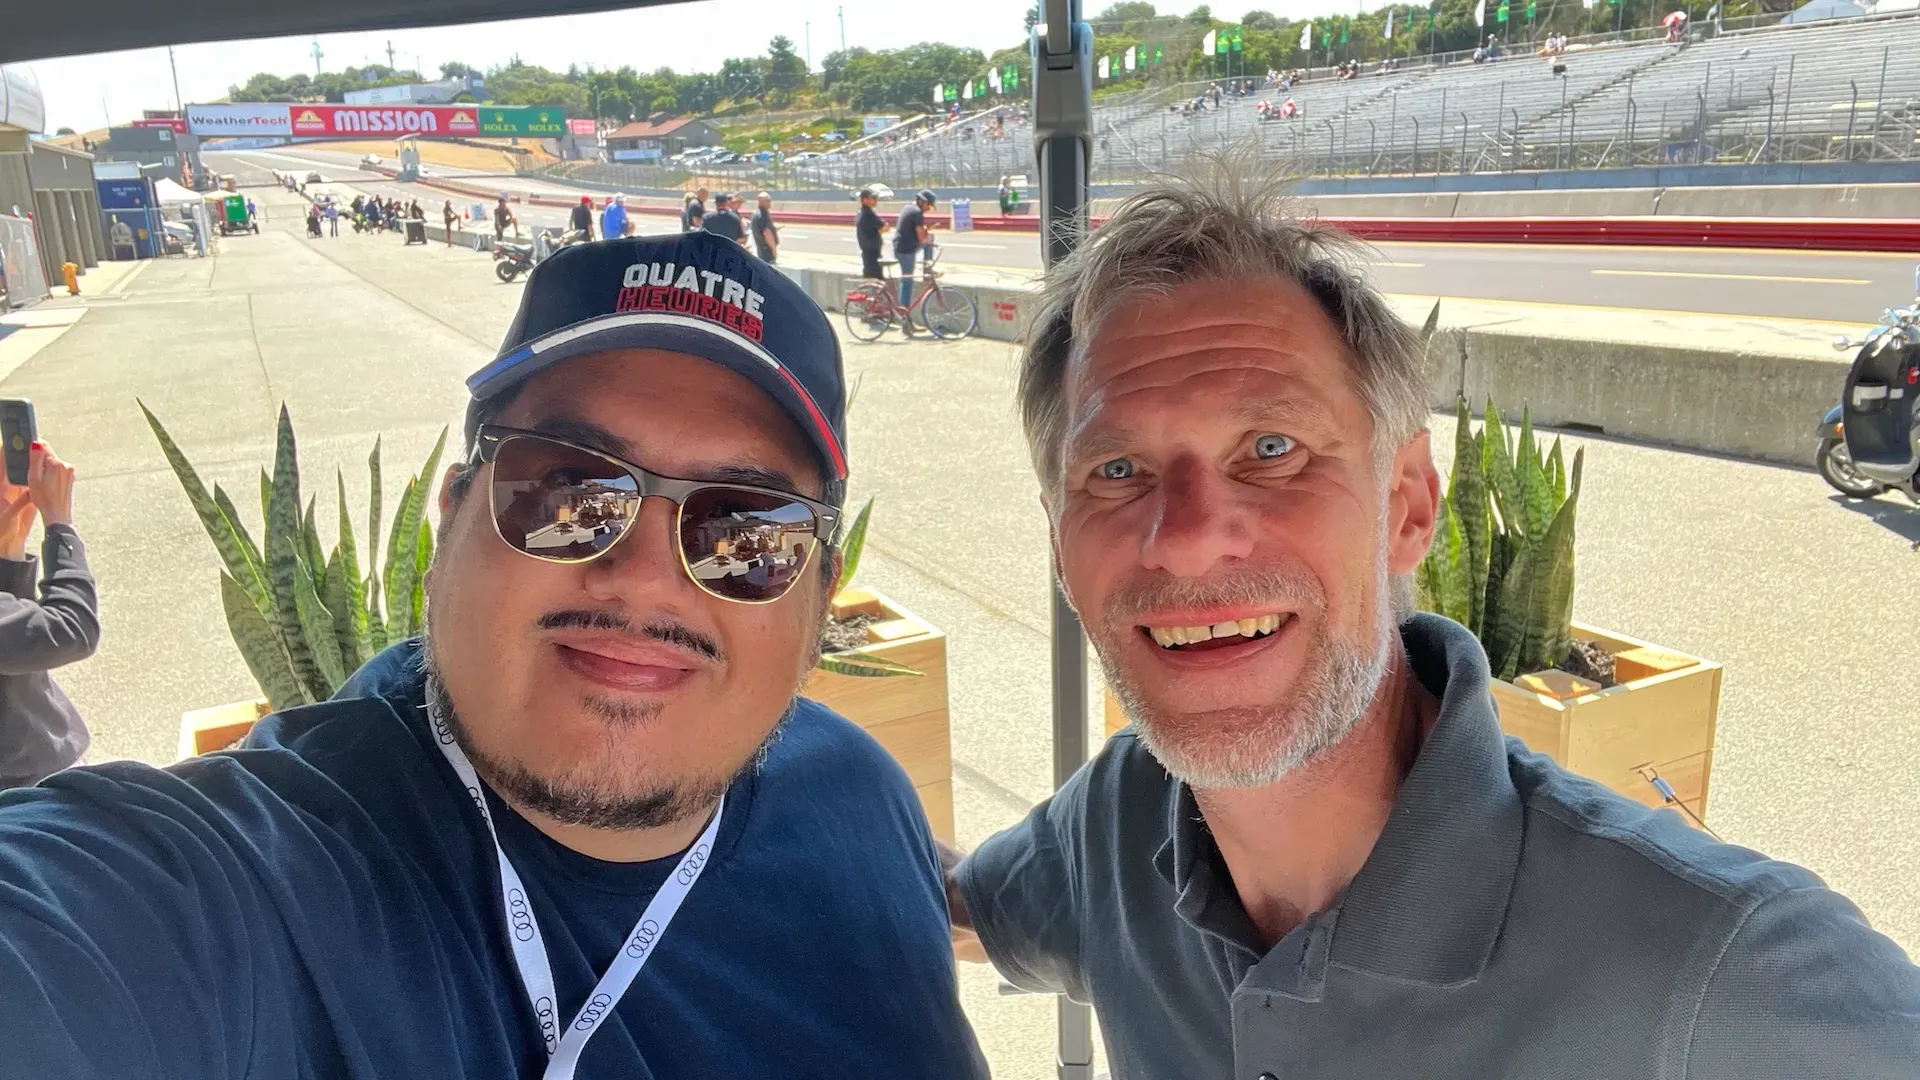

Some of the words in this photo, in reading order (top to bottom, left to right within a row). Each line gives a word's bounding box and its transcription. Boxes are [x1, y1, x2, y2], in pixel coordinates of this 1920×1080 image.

[192, 116, 287, 125] WeatherTech
[333, 110, 438, 131] MISSION
[484, 123, 518, 132] ROLEX
[528, 123, 562, 132] ROLEX
[623, 262, 765, 321] QUATRE
[615, 285, 764, 344] HEURES
